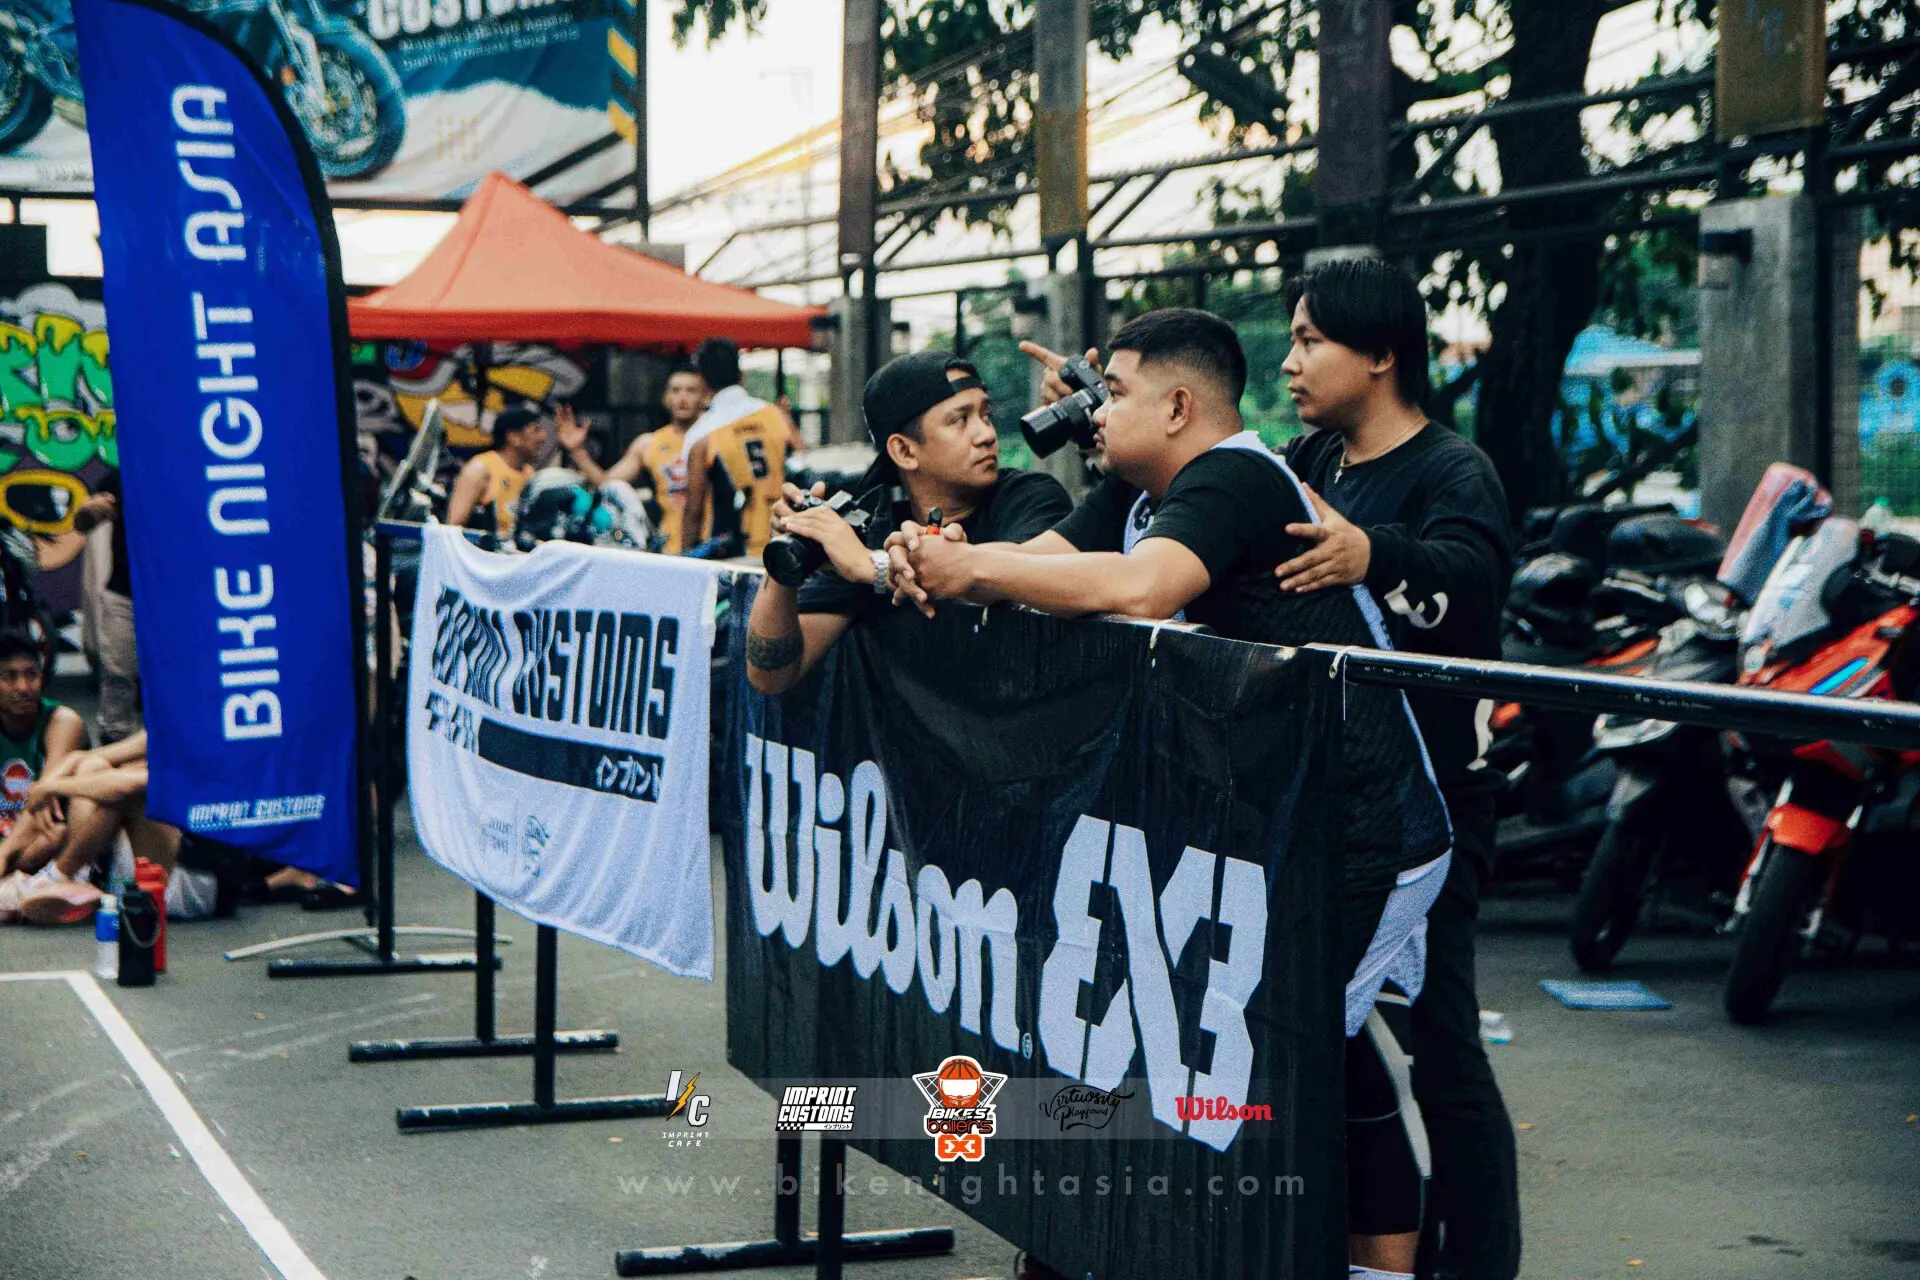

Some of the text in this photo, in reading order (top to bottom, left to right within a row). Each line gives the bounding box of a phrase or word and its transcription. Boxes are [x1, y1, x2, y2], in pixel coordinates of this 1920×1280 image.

[171, 85, 282, 740] BIKE NIGHT ASIA
[745, 440, 769, 478] 5
[746, 732, 1020, 1053] Wilson
